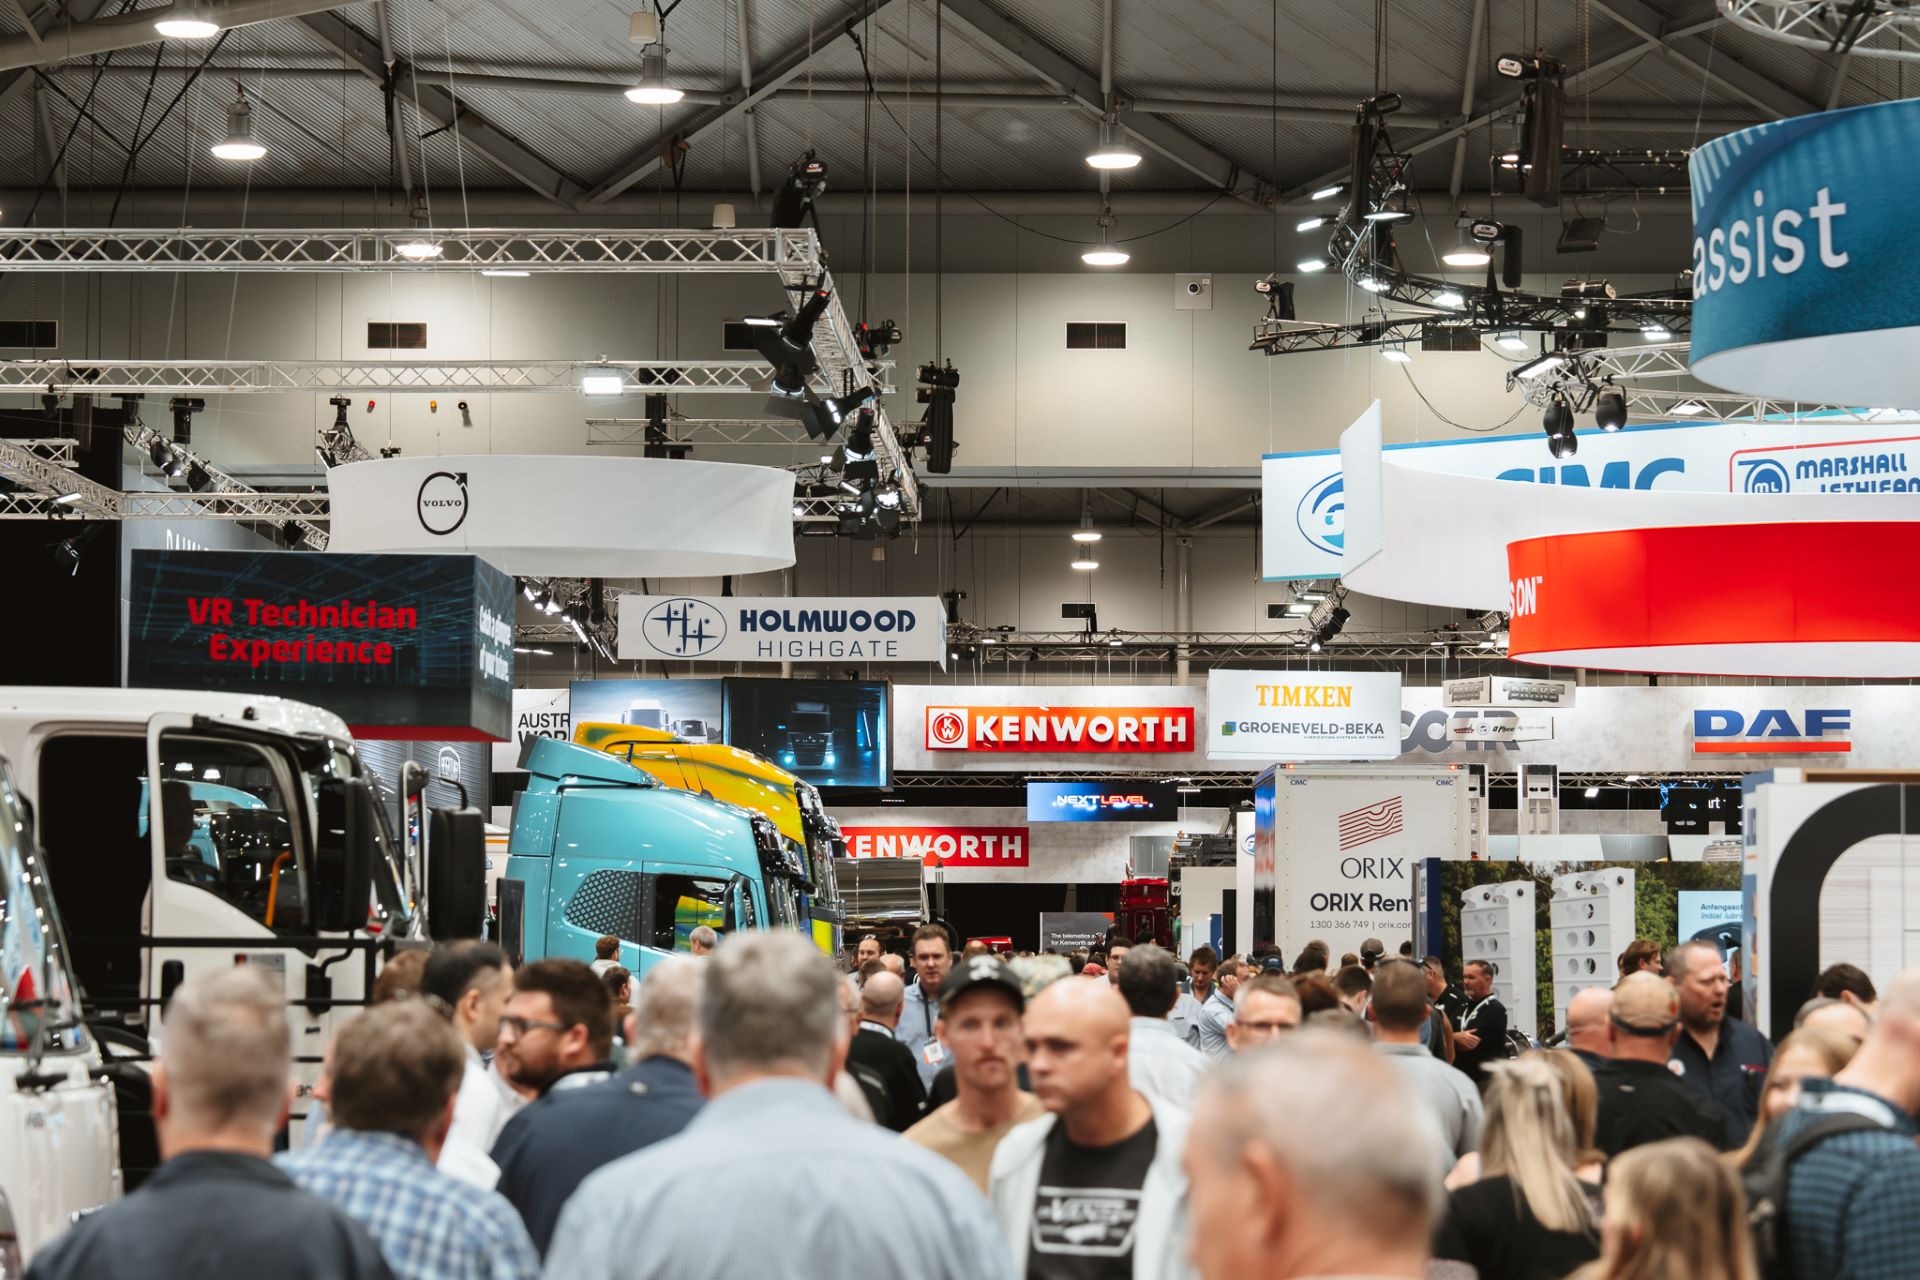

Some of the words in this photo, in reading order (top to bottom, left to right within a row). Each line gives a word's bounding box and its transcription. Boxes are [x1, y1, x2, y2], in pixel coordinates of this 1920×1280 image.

[1693, 186, 1849, 300] assist
[1795, 453, 1907, 480] MARSHALL
[187, 597, 233, 626] VR
[244, 599, 417, 630] Technician
[739, 609, 916, 633] HOLMWOOD
[209, 633, 394, 669] Experience
[757, 640, 899, 658] HIGHGATE
[1255, 684, 1353, 708] TIMKEN
[975, 715, 1187, 743] KENWORTH
[1239, 721, 1385, 735] GROENEVELD-BEKA
[1694, 709, 1851, 737] DAF
[1340, 857, 1404, 879] ORIX
[1310, 893, 1364, 912] ORIX
[1310, 920, 1333, 929] 1300
[1334, 920, 1351, 929] 366
[1353, 920, 1369, 929] 749
